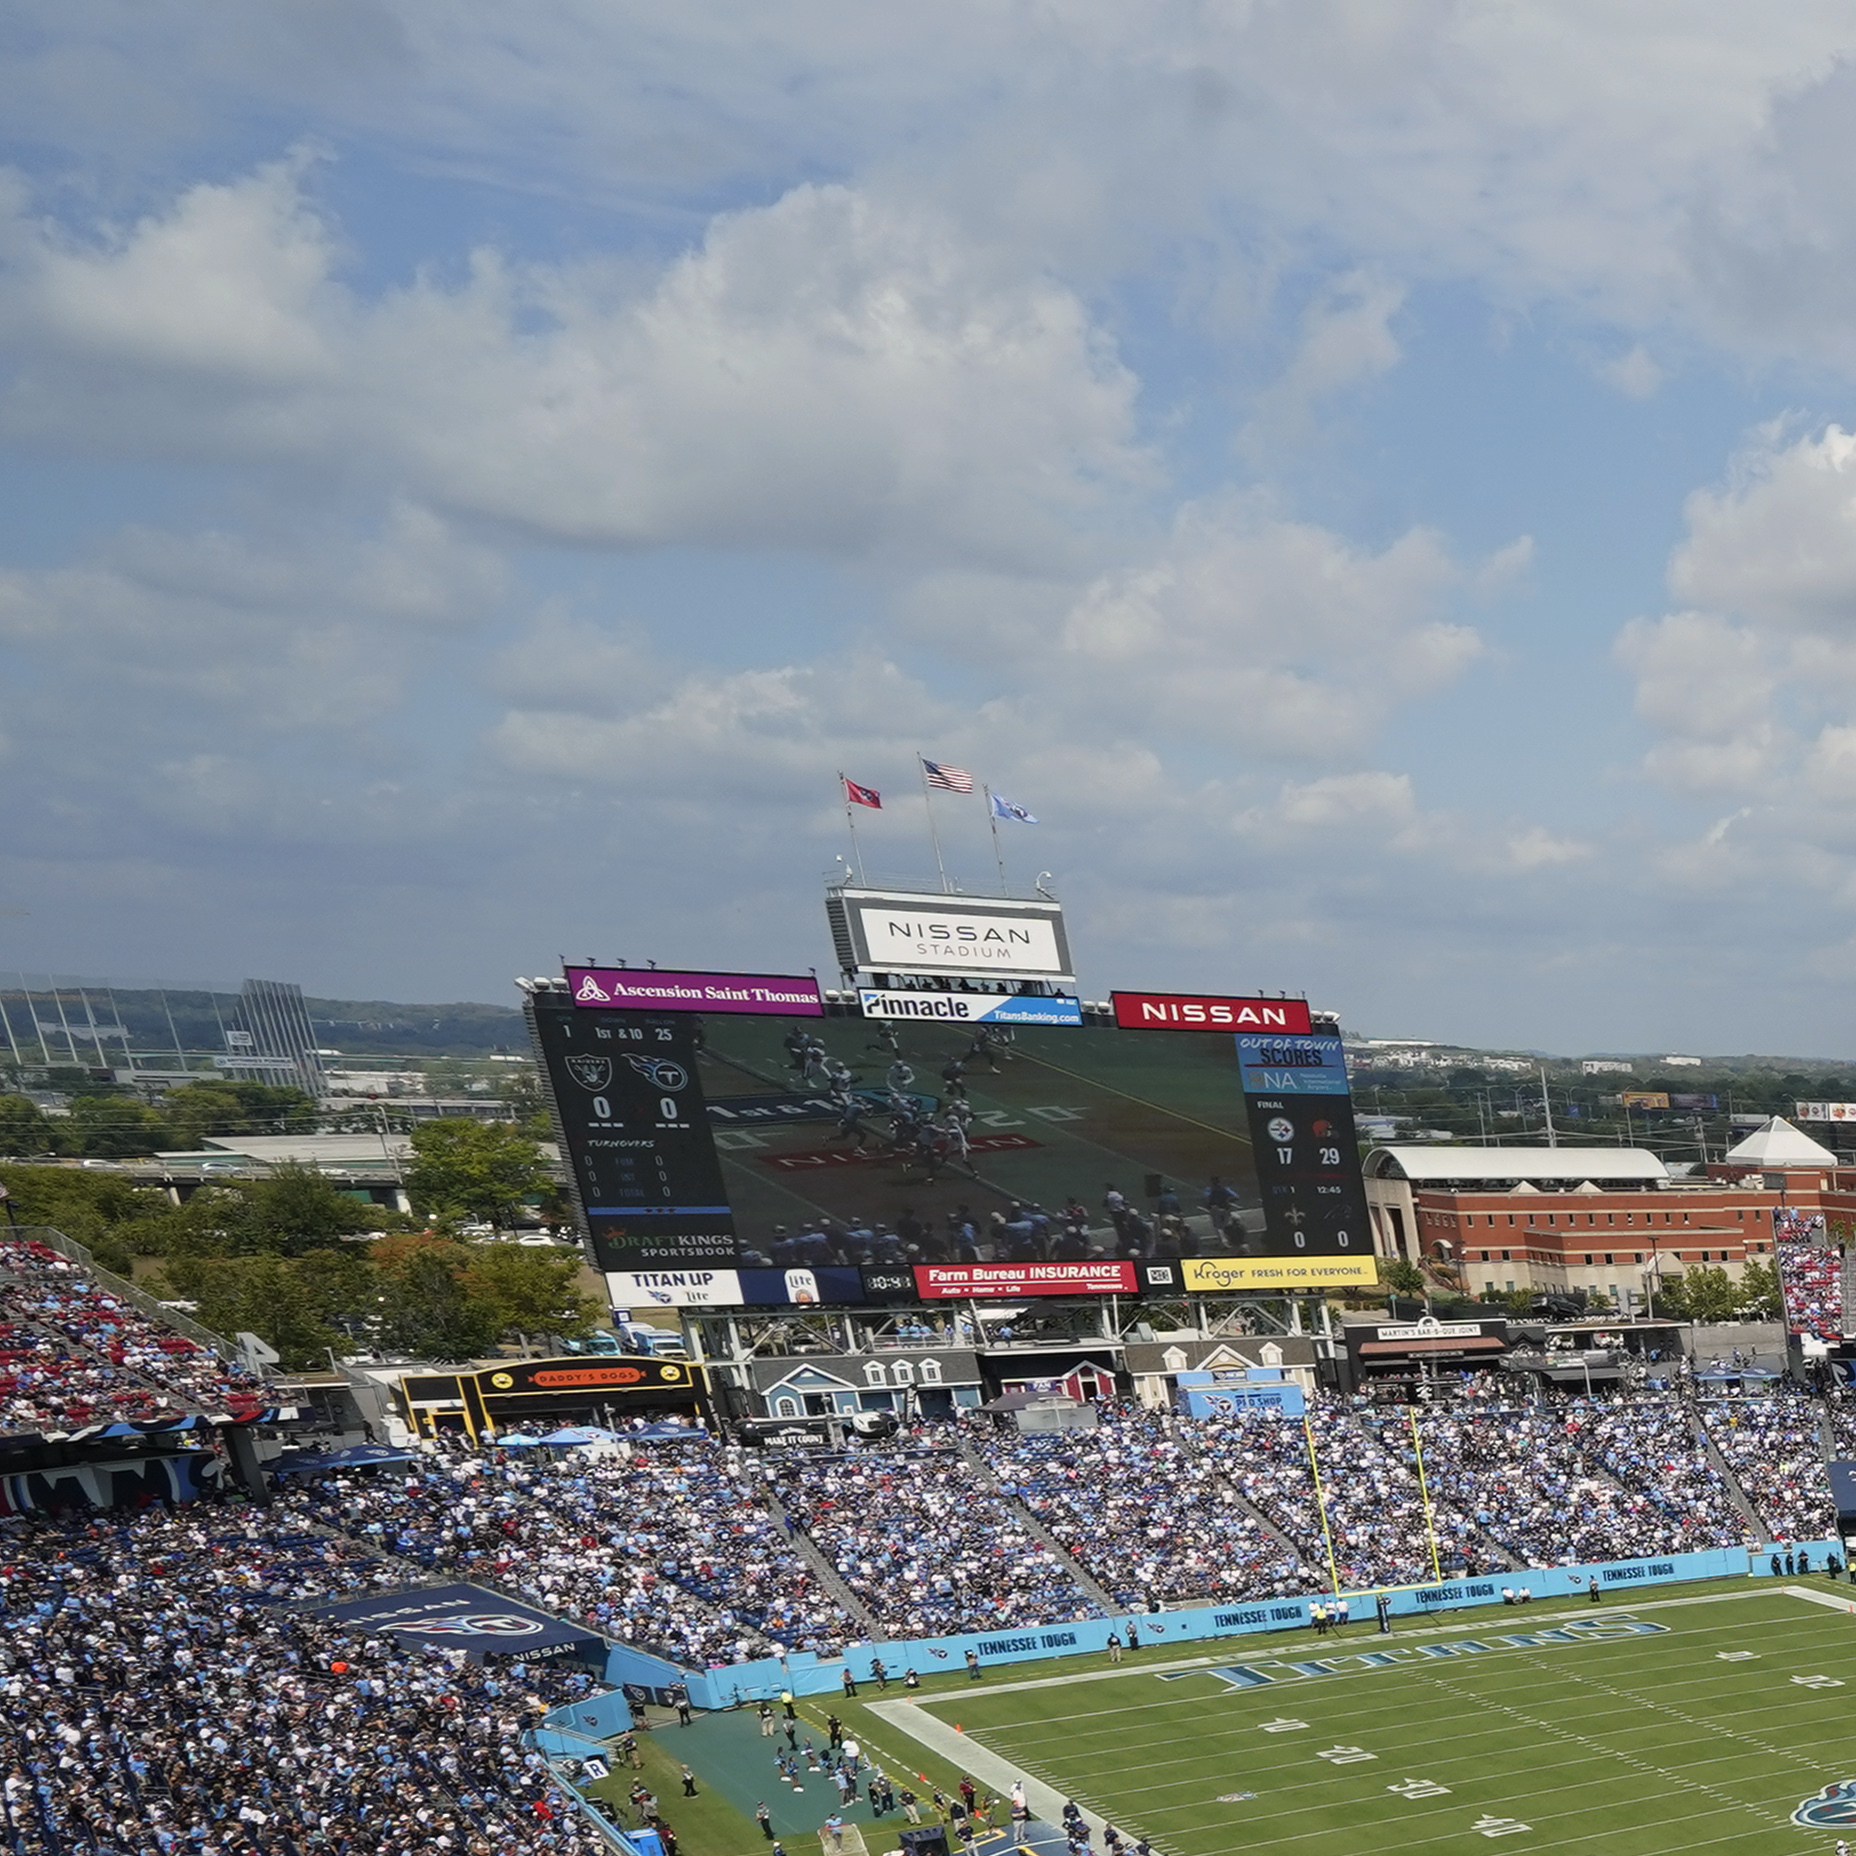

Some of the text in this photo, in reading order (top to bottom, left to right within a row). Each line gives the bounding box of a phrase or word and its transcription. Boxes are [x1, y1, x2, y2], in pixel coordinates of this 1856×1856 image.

[889, 922, 1030, 944] NISSAN
[916, 944, 1011, 959] STADIUM
[614, 982, 818, 1004] Ascension Saint Thomas
[867, 994, 970, 1018] Pinnacle
[1141, 1002, 1286, 1025] NISSAN
[994, 1010, 1079, 1024] TitansBanking.com
[629, 1027, 643, 1040] 10
[655, 1028, 673, 1041] 25
[1240, 1038, 1341, 1052] OUT OF TOWN
[1260, 1051, 1324, 1066] SCORES
[593, 1096, 611, 1119] 0
[660, 1097, 678, 1119] 0
[1257, 1101, 1284, 1110] FINAL
[587, 1139, 655, 1149] TURNOVERS
[1277, 1147, 1293, 1165] 17
[1319, 1148, 1341, 1165] 29
[607, 1233, 734, 1250] DRAFTKINGS
[1294, 1231, 1306, 1249] 0
[1337, 1230, 1349, 1248] 0
[641, 1247, 736, 1258] SPORTSBOOK
[631, 1272, 714, 1288] TITAN UP
[929, 1264, 1121, 1282] Farm Bureau INSURANCE
[1194, 1261, 1244, 1287] Kroger
[1251, 1269, 1283, 1278] FRESH
[1286, 1268, 1307, 1277] FOR
[540, 1371, 635, 1384] DADDY'S DOGS
[1603, 1562, 1674, 1583] TENNESSEE TOUGH
[1416, 1583, 1495, 1605] TENNESSEE TOUGH
[1214, 1605, 1303, 1628] TENNESSEE TOUGH
[512, 1642, 577, 1662] NISSAN
[978, 1631, 1077, 1657] TENNESSEE TOUGH
[1153, 1614, 1672, 1693] TITANS
[1316, 1744, 1378, 1766] 20
[1386, 1779, 1453, 1801] 30
[1470, 1816, 1534, 1838] 40
